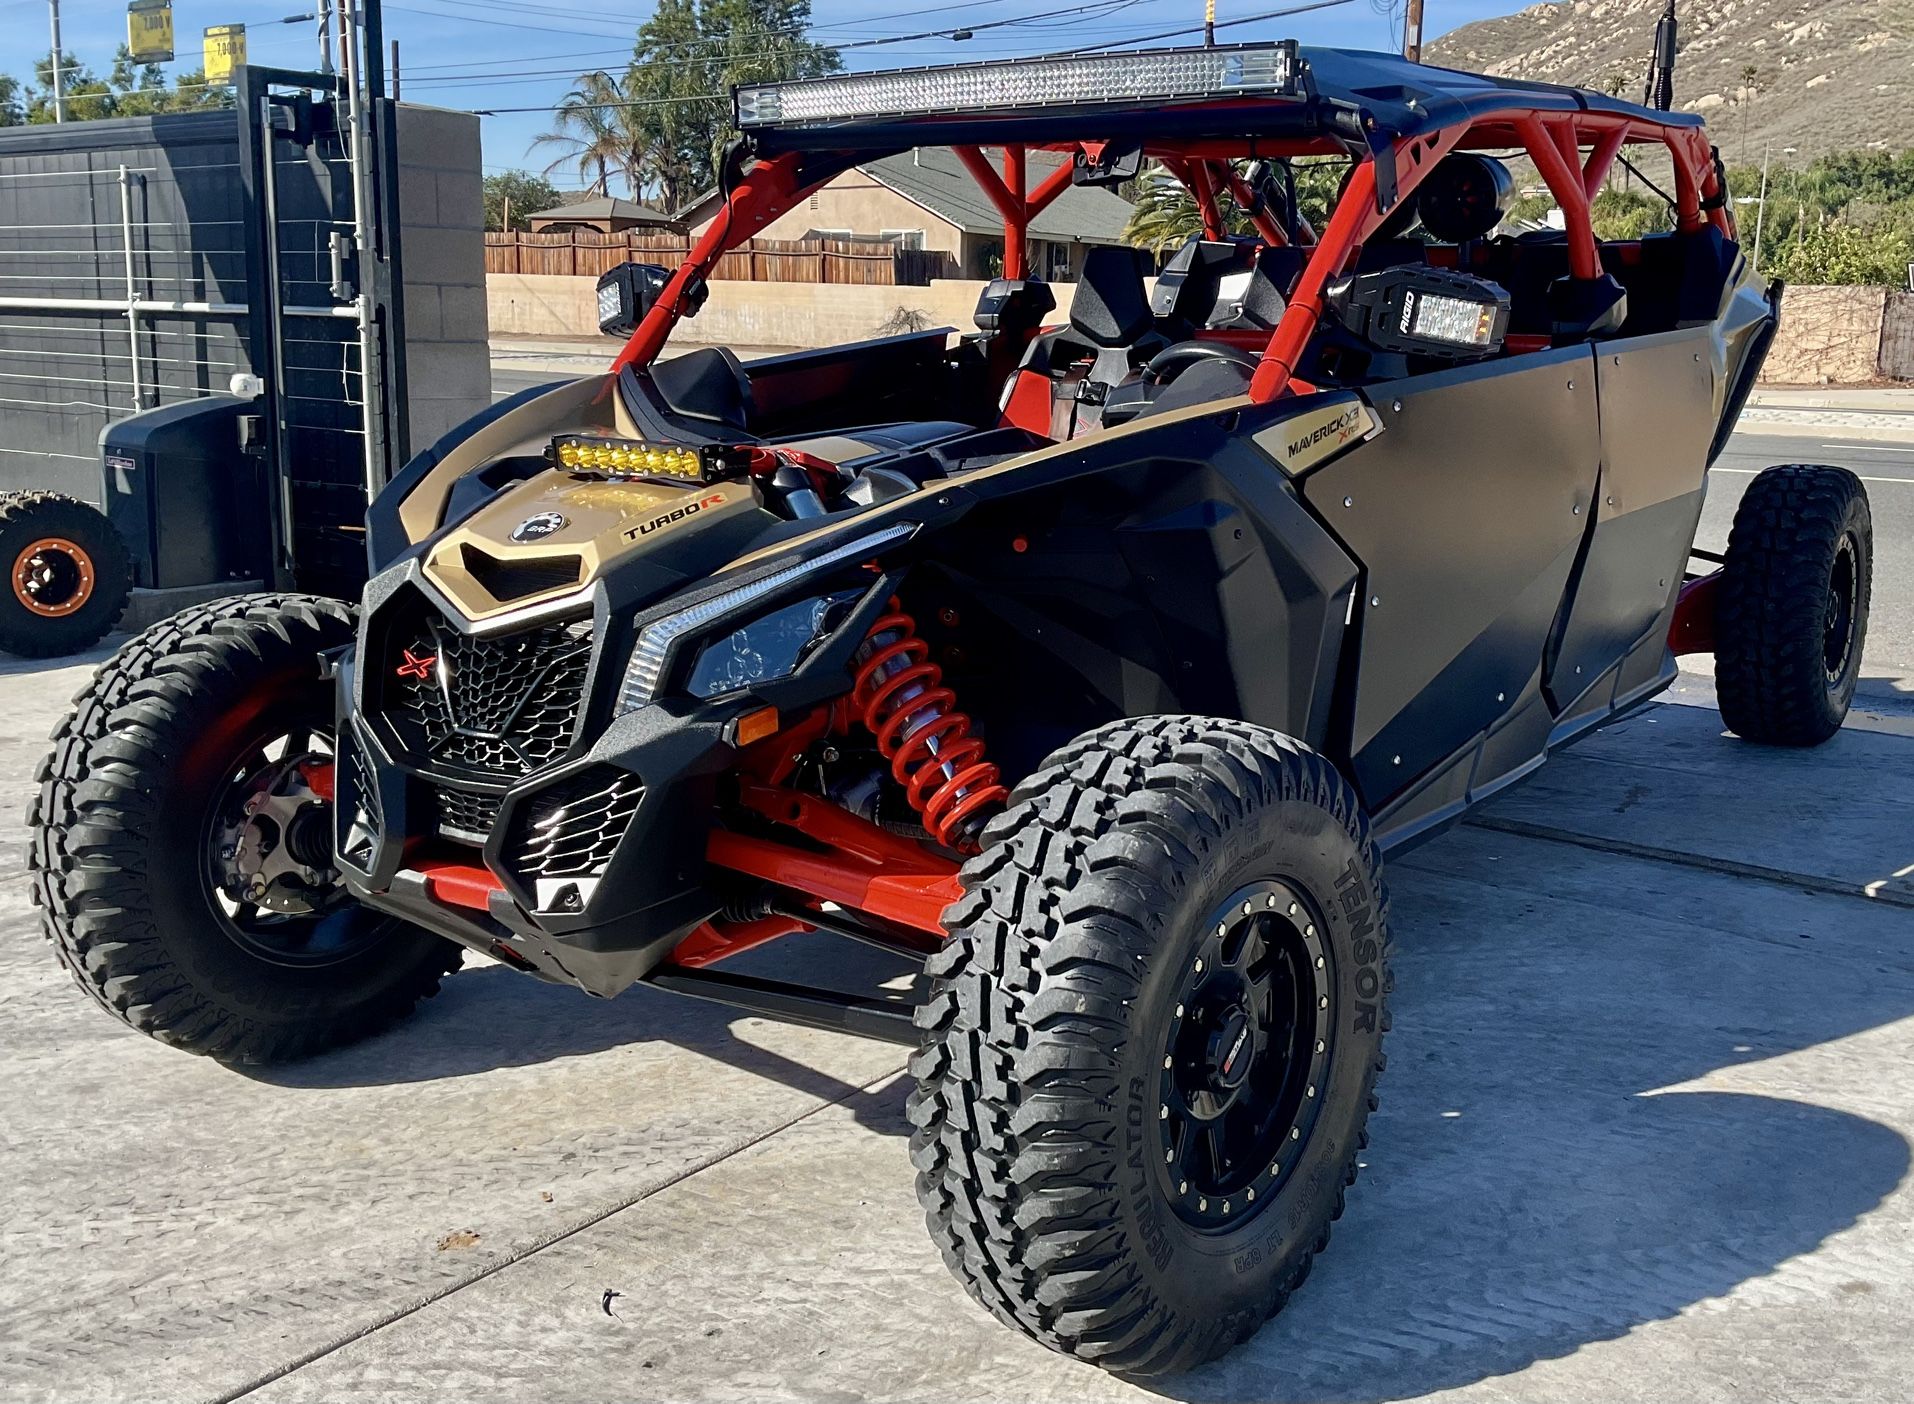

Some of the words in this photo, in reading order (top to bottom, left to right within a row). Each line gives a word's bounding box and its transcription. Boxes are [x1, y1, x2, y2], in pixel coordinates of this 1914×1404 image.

[217, 41, 237, 56] 7,000
[1400, 291, 1415, 334] RIGID
[1288, 415, 1344, 458] MAVERICK
[527, 525, 554, 534] BRP
[1333, 857, 1379, 1034] TENSOR
[1126, 1075, 1175, 1273] REGULATOR
[1234, 1247, 1262, 1274] 8PR
